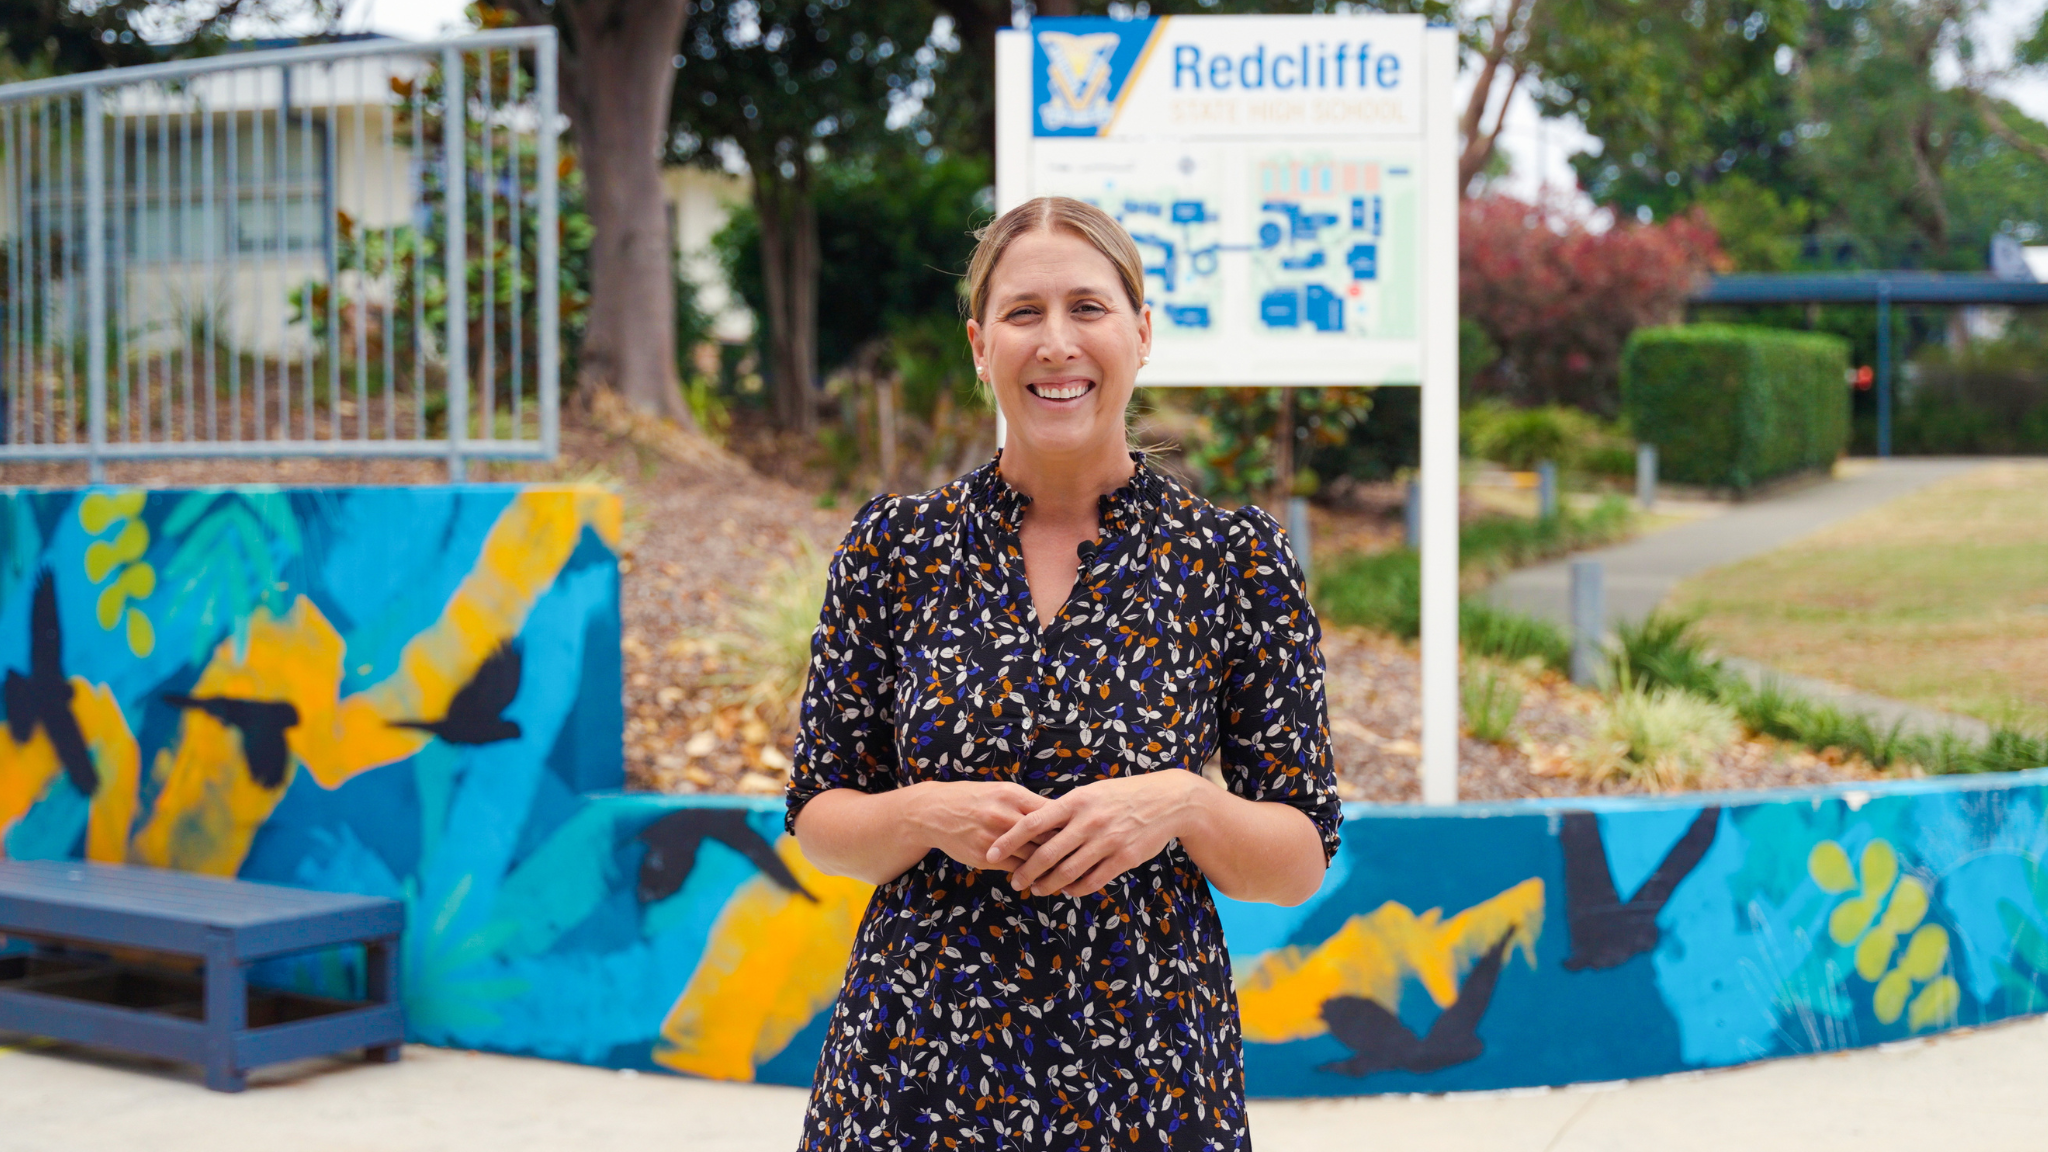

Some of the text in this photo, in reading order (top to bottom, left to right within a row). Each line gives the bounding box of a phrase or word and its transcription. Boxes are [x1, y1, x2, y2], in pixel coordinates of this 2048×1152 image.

[1173, 43, 1401, 89] Redcliffe
[1171, 101, 1407, 122] STATE HIGH SCHOOL
